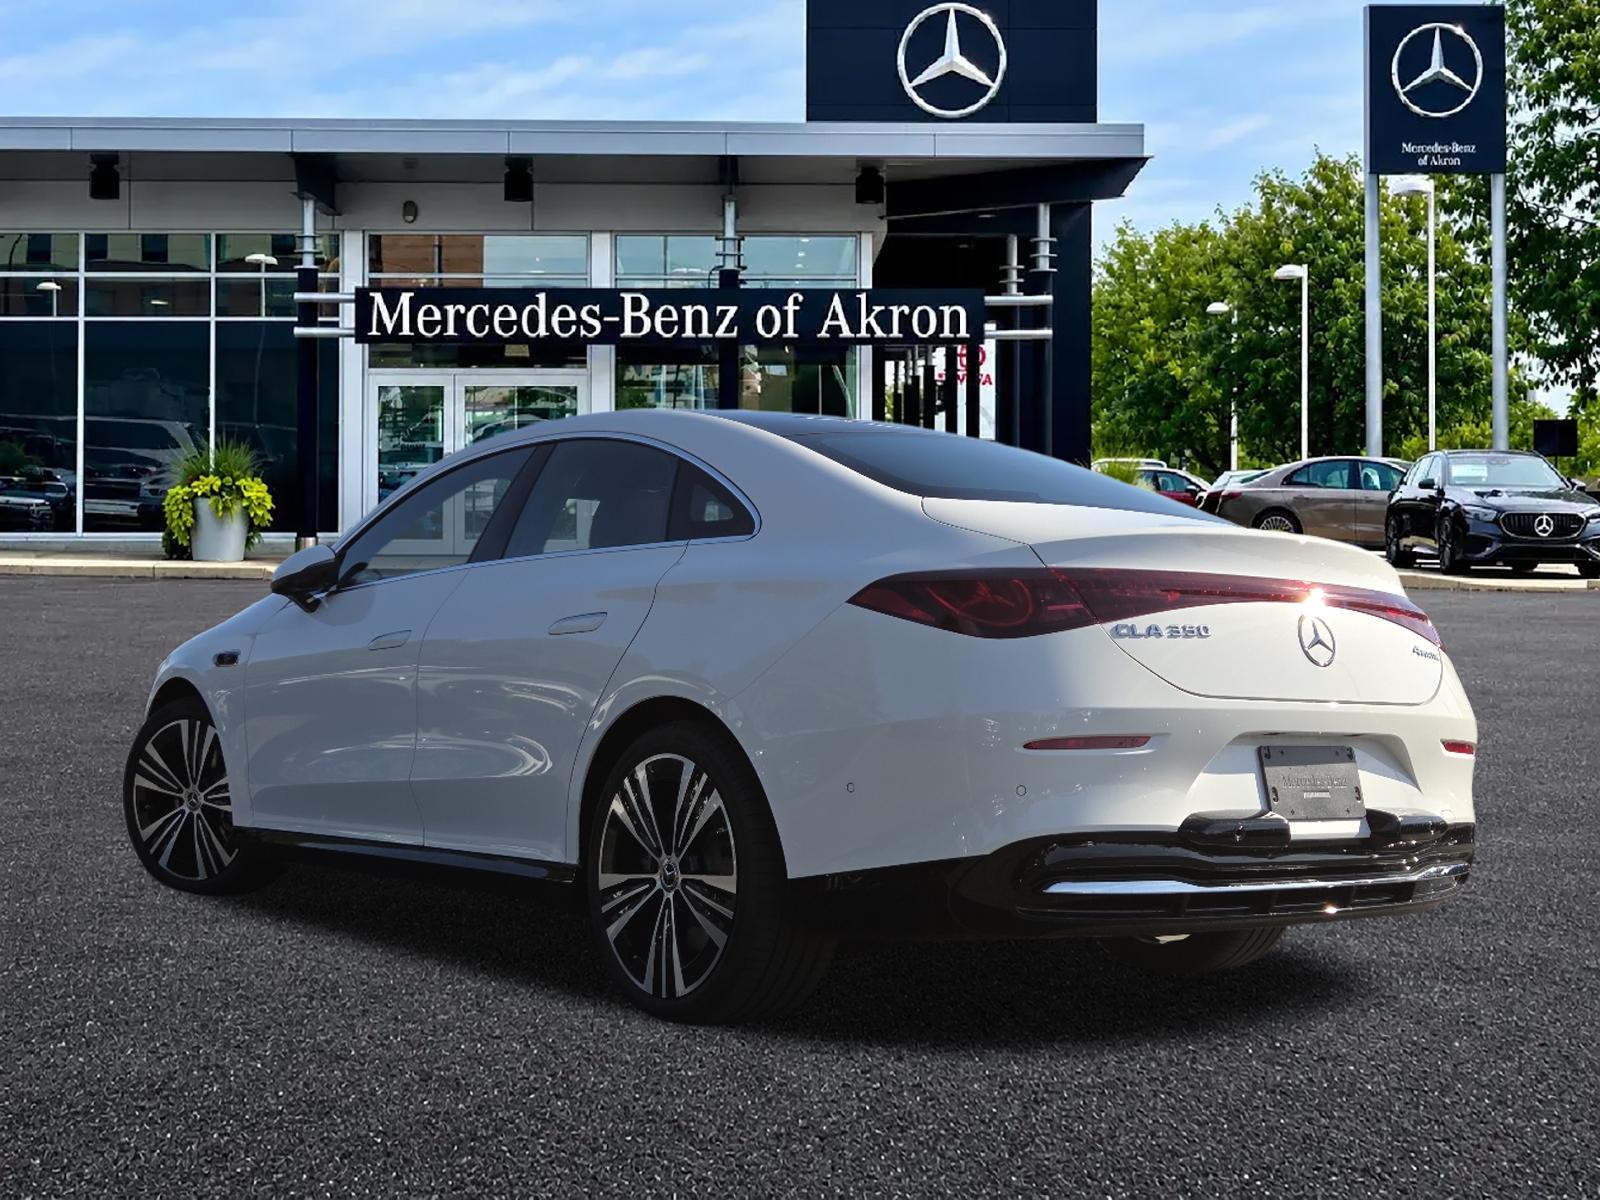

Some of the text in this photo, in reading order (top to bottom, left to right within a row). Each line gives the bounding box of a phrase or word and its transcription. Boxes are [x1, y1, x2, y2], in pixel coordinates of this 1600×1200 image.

[1401, 142, 1477, 154] Mercedes-Benz
[1417, 154, 1461, 166] of Akron
[368, 291, 971, 338] Mercedes-Benz of Akron
[1110, 623, 1211, 639] CLA 350
